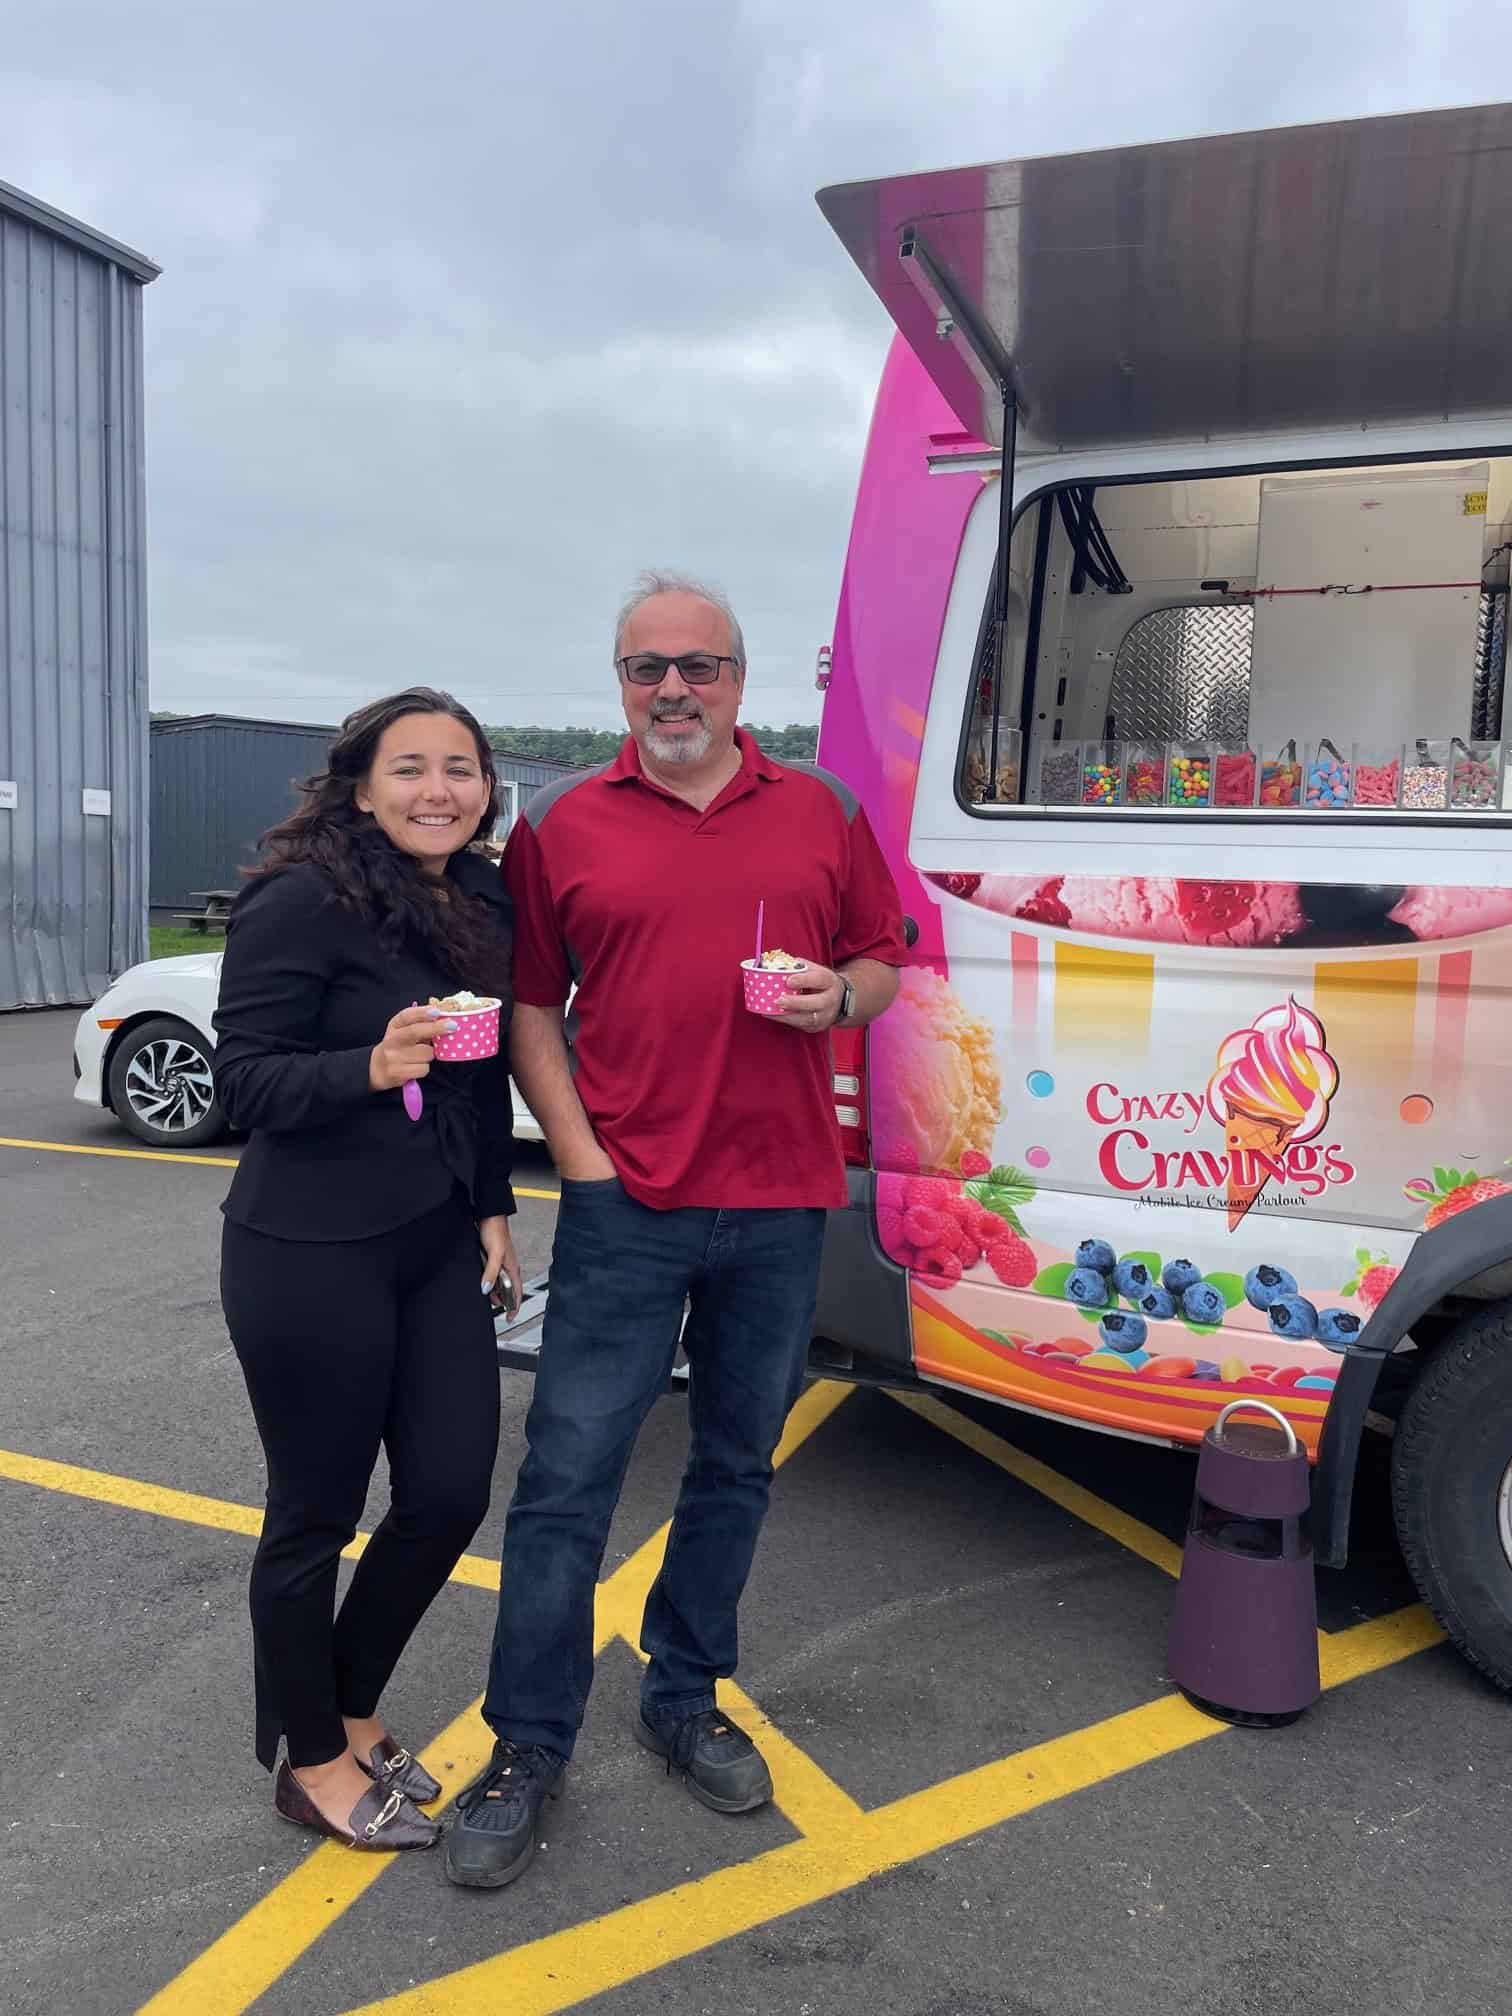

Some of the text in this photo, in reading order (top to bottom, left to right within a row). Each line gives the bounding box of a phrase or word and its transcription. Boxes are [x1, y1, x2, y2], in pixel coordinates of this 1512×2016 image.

[1134, 1193, 1307, 1208] Mobile Ice Cream Parlour
